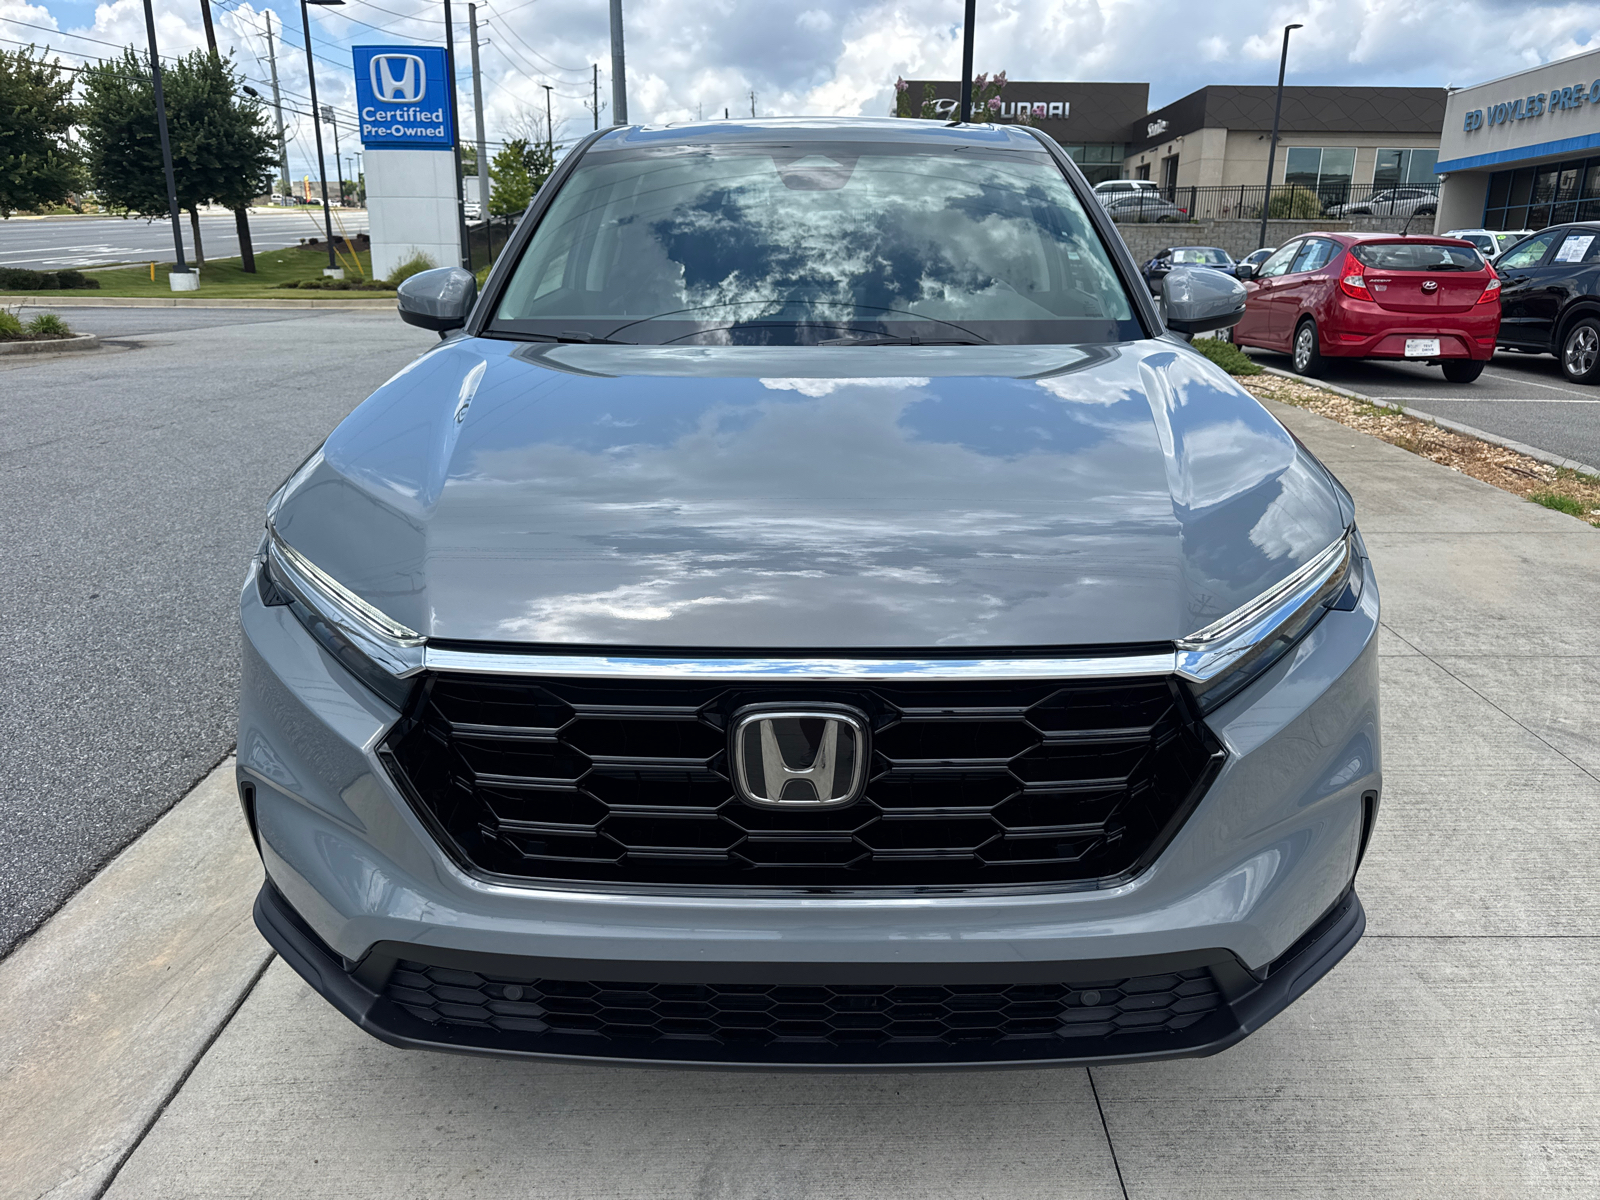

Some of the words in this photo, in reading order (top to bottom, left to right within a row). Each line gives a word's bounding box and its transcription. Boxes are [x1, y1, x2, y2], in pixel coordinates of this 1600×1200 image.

[362, 106, 444, 122] Certified
[1463, 109, 1483, 132] ED
[1487, 93, 1546, 127] VOYLES
[363, 124, 445, 137] Pre-Owned
